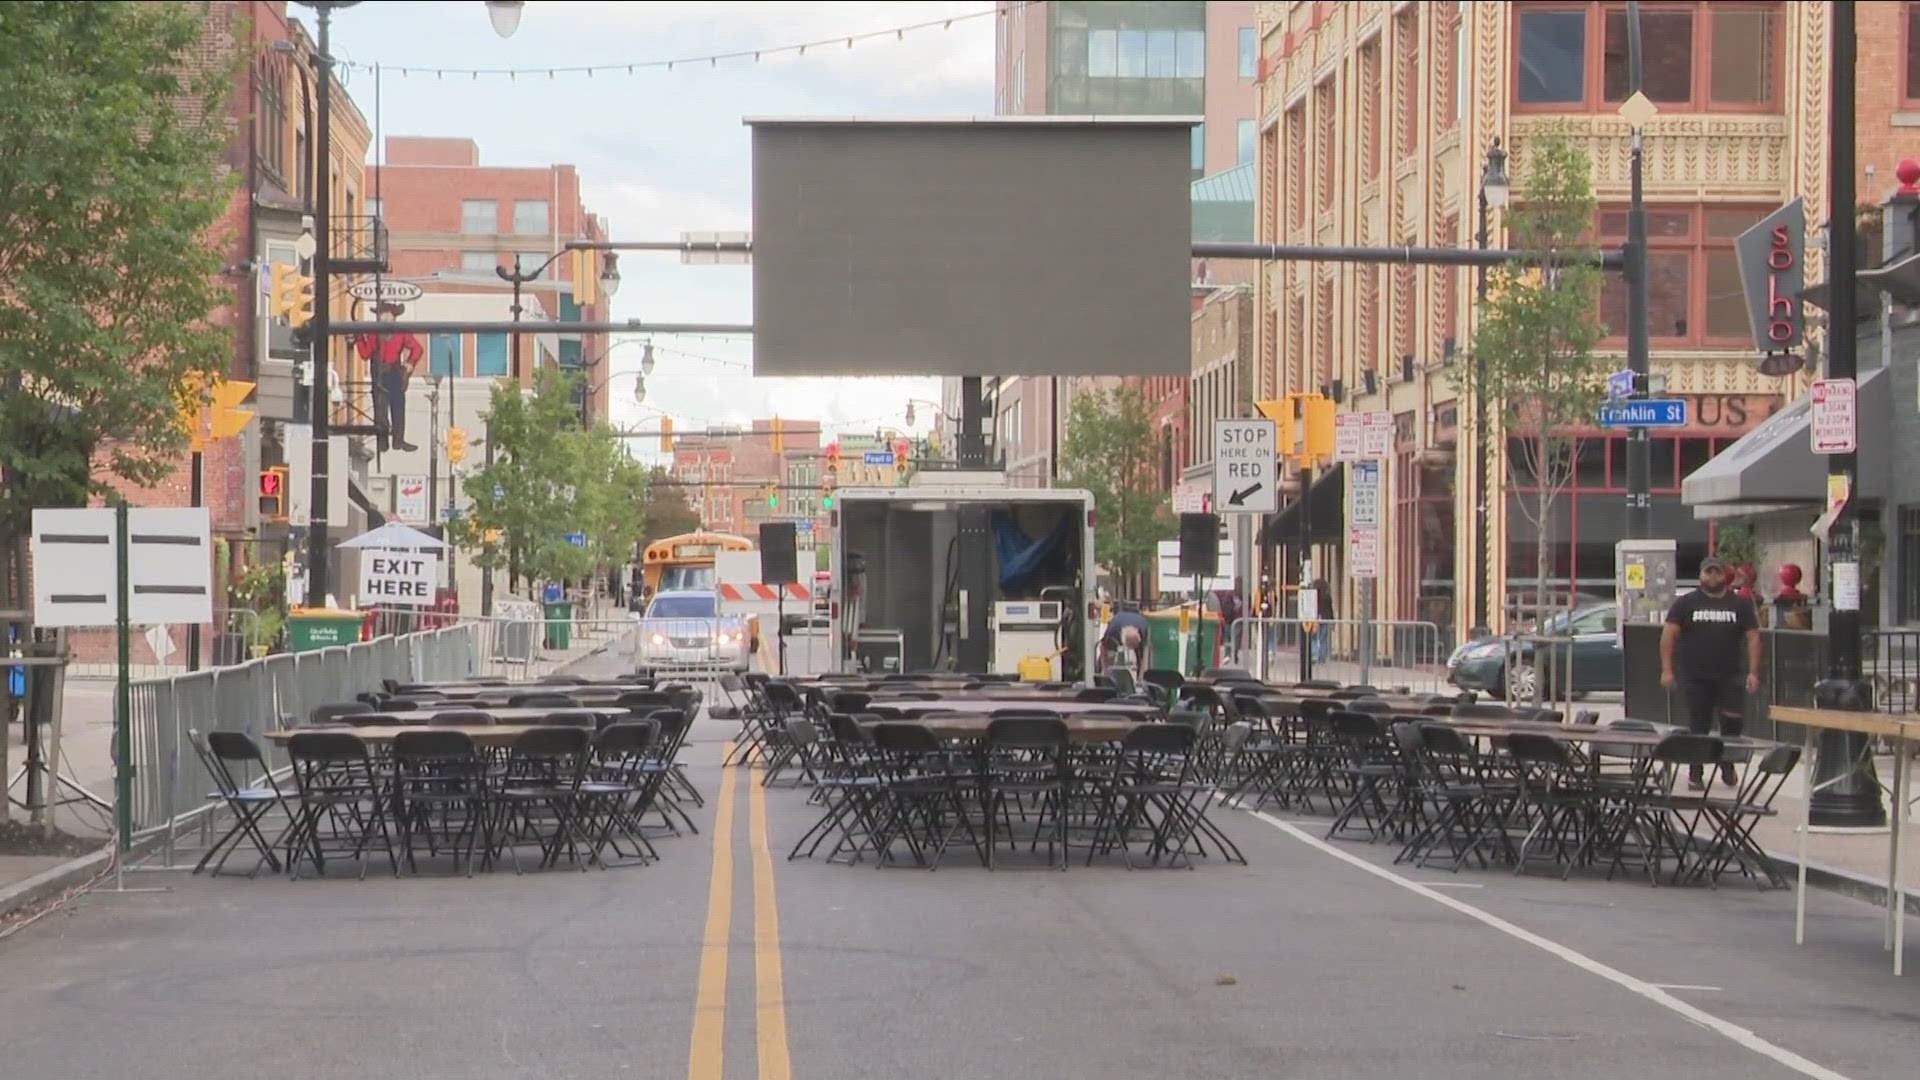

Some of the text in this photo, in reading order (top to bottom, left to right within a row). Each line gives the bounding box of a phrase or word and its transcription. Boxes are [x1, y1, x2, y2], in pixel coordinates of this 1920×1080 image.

[1768, 223, 1793, 342] soho
[1666, 404, 1681, 421] St
[1223, 428, 1267, 443] STOP
[1220, 448, 1270, 458] HERE ON
[1229, 462, 1261, 477] RED
[372, 558, 424, 576] EXIT
[367, 579, 428, 597] HERE
[1692, 610, 1737, 623] SECURITY
